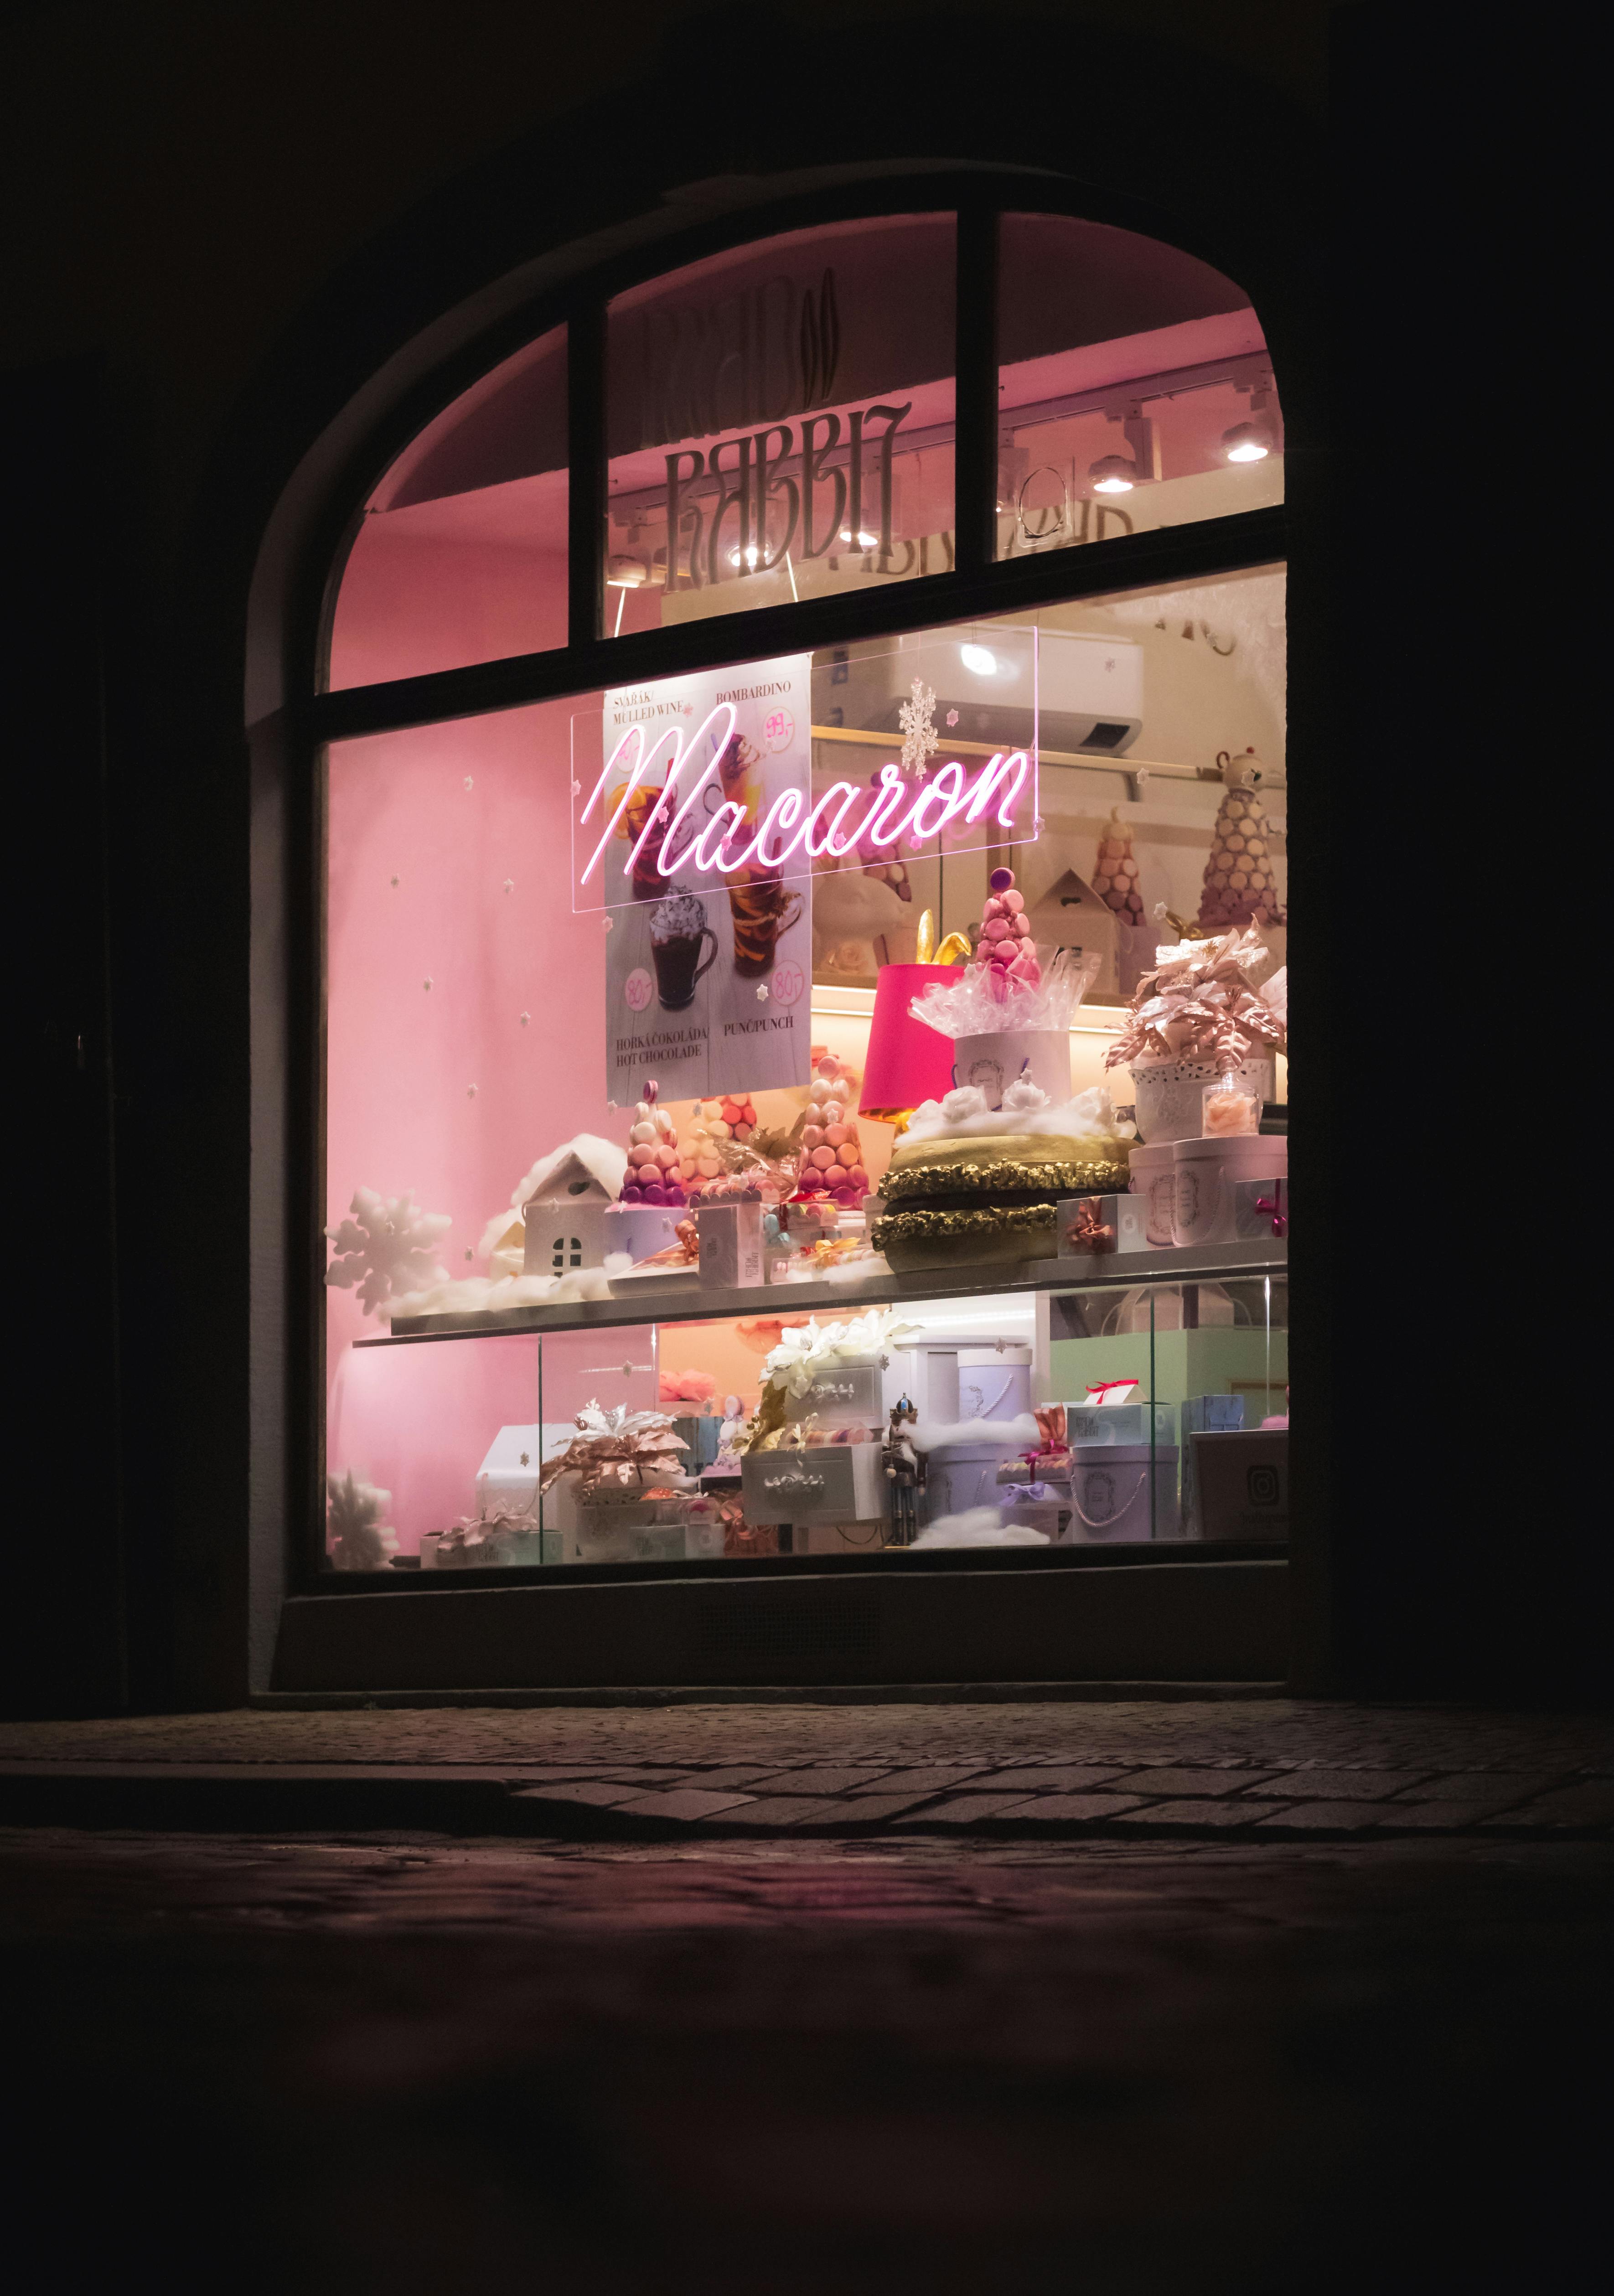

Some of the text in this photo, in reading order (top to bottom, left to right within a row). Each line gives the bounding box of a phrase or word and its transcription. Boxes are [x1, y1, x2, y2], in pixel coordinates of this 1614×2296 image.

[665, 401, 912, 594] RABBIT
[716, 680, 791, 705] BOMBARDINO
[613, 700, 683, 725] MULLED WINE
[580, 702, 1029, 885] Macaron
[616, 1032, 651, 1051] HORKÁ
[617, 1044, 702, 1067] HOT CHOCOLADE
